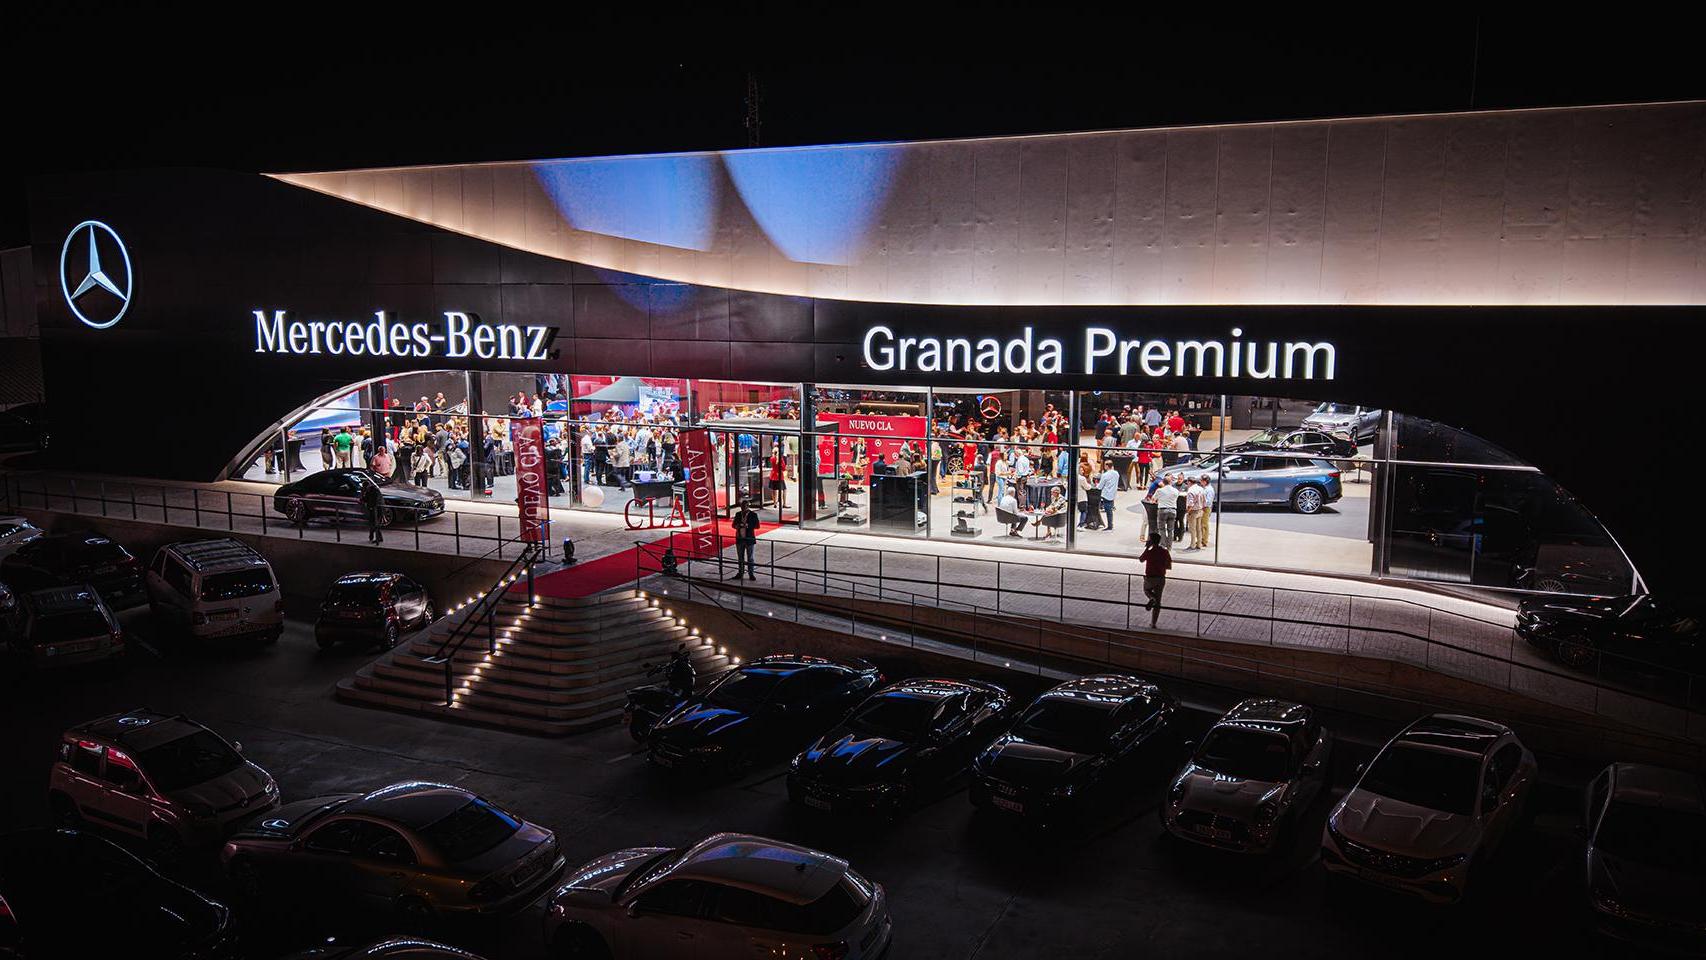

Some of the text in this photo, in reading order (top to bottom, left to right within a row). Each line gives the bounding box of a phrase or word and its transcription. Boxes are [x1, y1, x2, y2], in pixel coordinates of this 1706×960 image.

[252, 309, 548, 360] Mercedes-Benz
[863, 326, 1336, 380] Granada Premium
[849, 420, 876, 431] NUEVO
[624, 496, 690, 530] CLA
